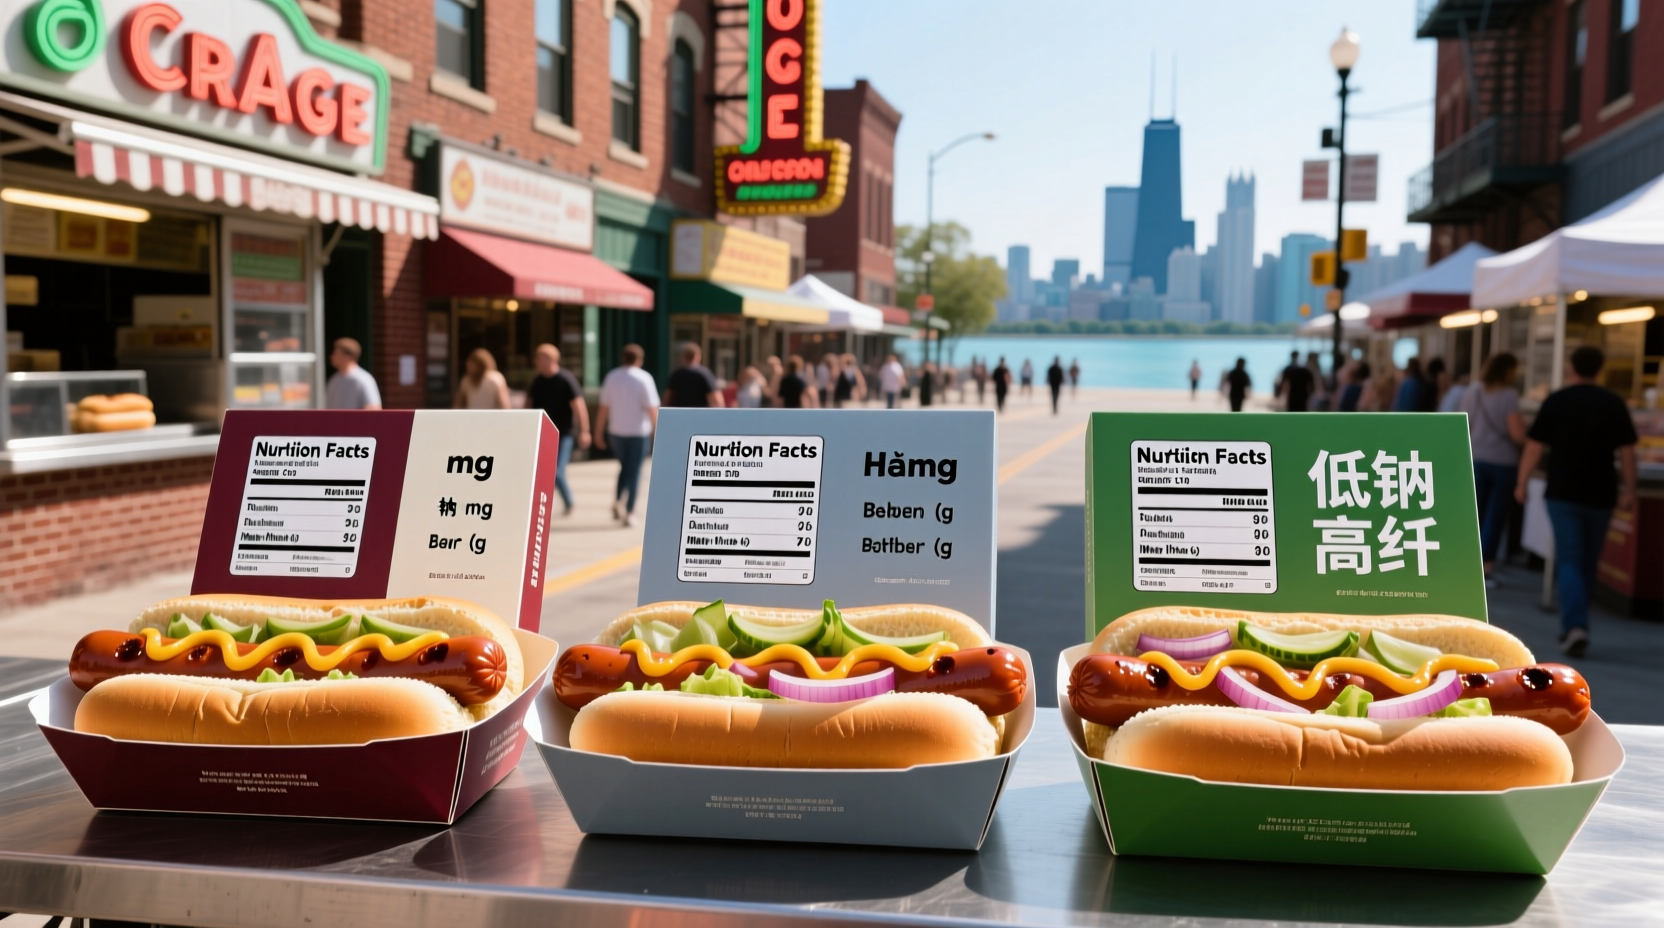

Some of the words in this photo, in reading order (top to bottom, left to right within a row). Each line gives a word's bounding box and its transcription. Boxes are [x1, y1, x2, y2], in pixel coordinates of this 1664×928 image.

[326, 443, 370, 458] Facts
[769, 442, 817, 458] Facts
[1216, 448, 1267, 464] Facts
[446, 455, 494, 481] mg
[1307, 449, 1435, 510] 低钠
[465, 503, 493, 520] mg
[1312, 514, 1440, 576] 高纤
